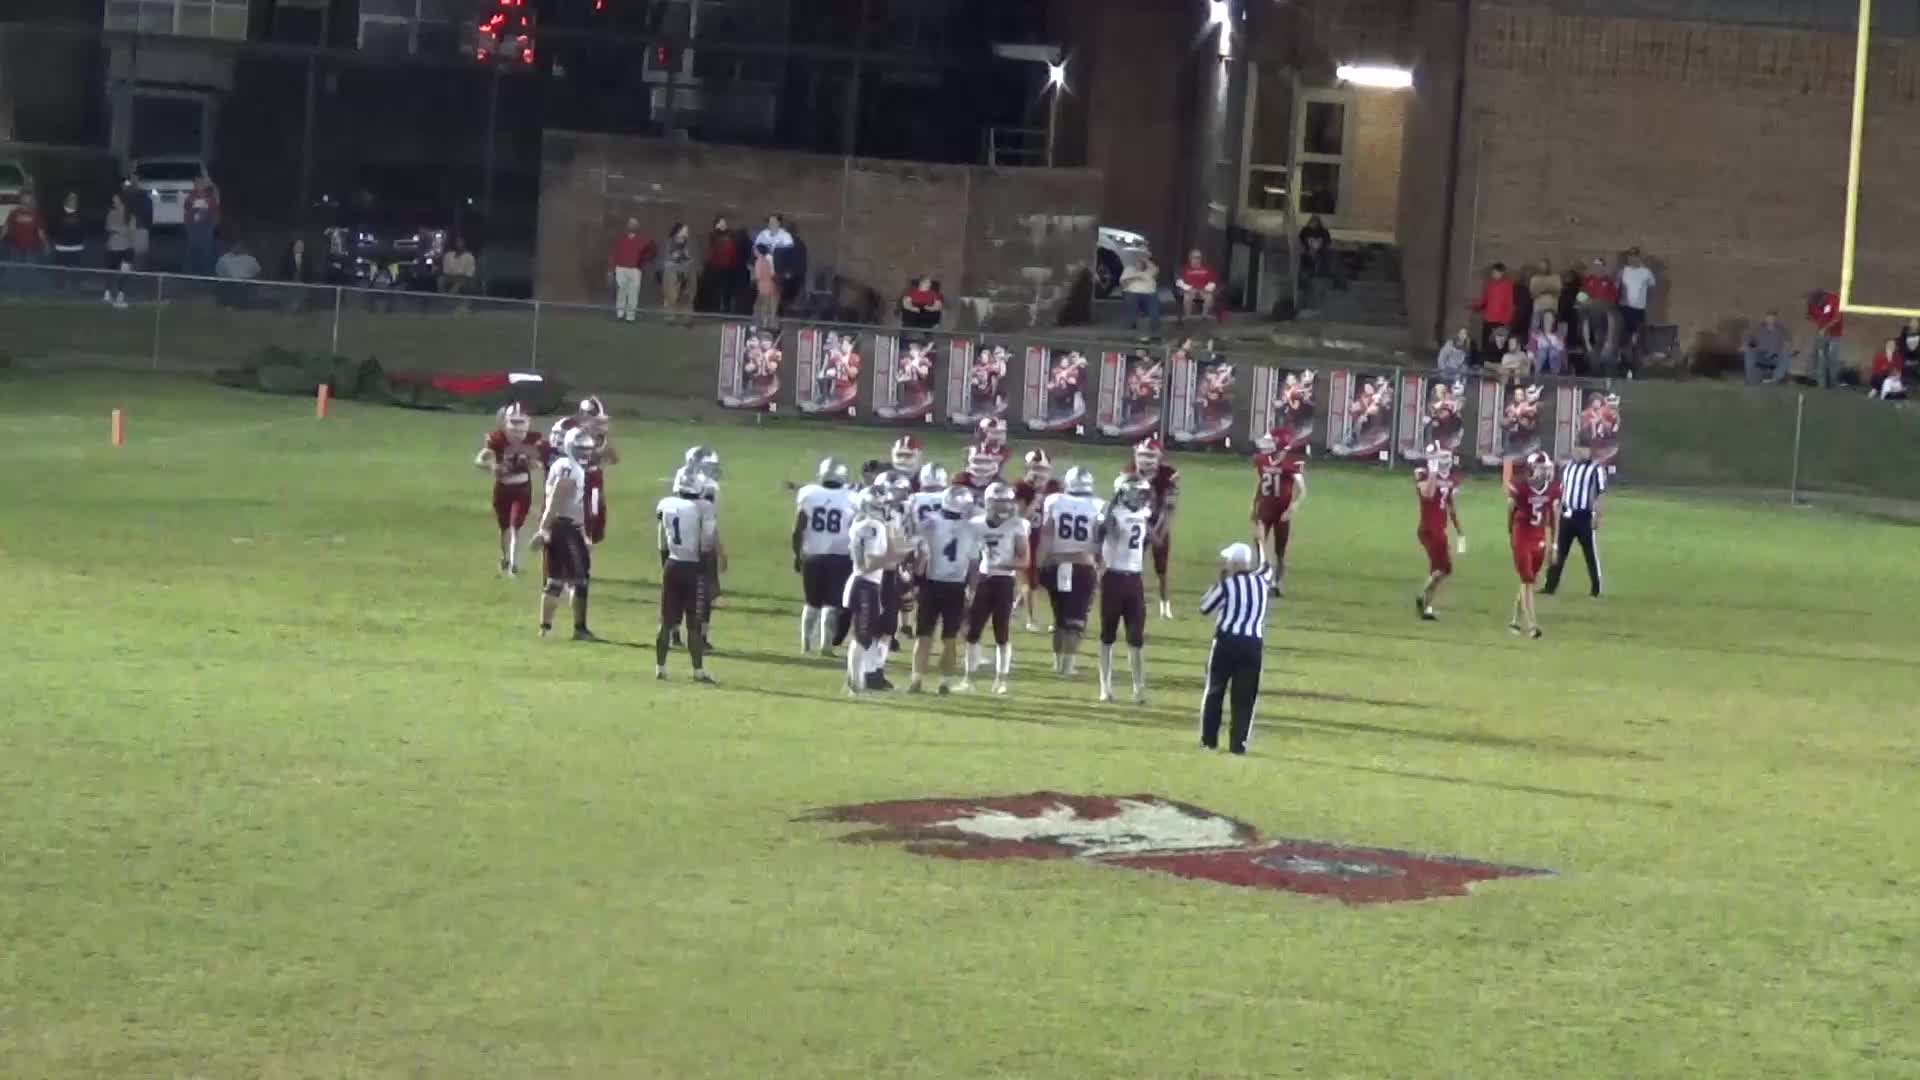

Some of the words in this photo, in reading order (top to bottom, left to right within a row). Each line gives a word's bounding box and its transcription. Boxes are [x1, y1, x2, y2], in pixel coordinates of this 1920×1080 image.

[1261, 472, 1280, 496] 21
[811, 507, 842, 533] 68
[1529, 503, 1543, 525] 5
[672, 517, 682, 545] 1
[1058, 513, 1088, 541] 66
[1128, 525, 1141, 549] 2
[943, 537, 958, 562] 4
